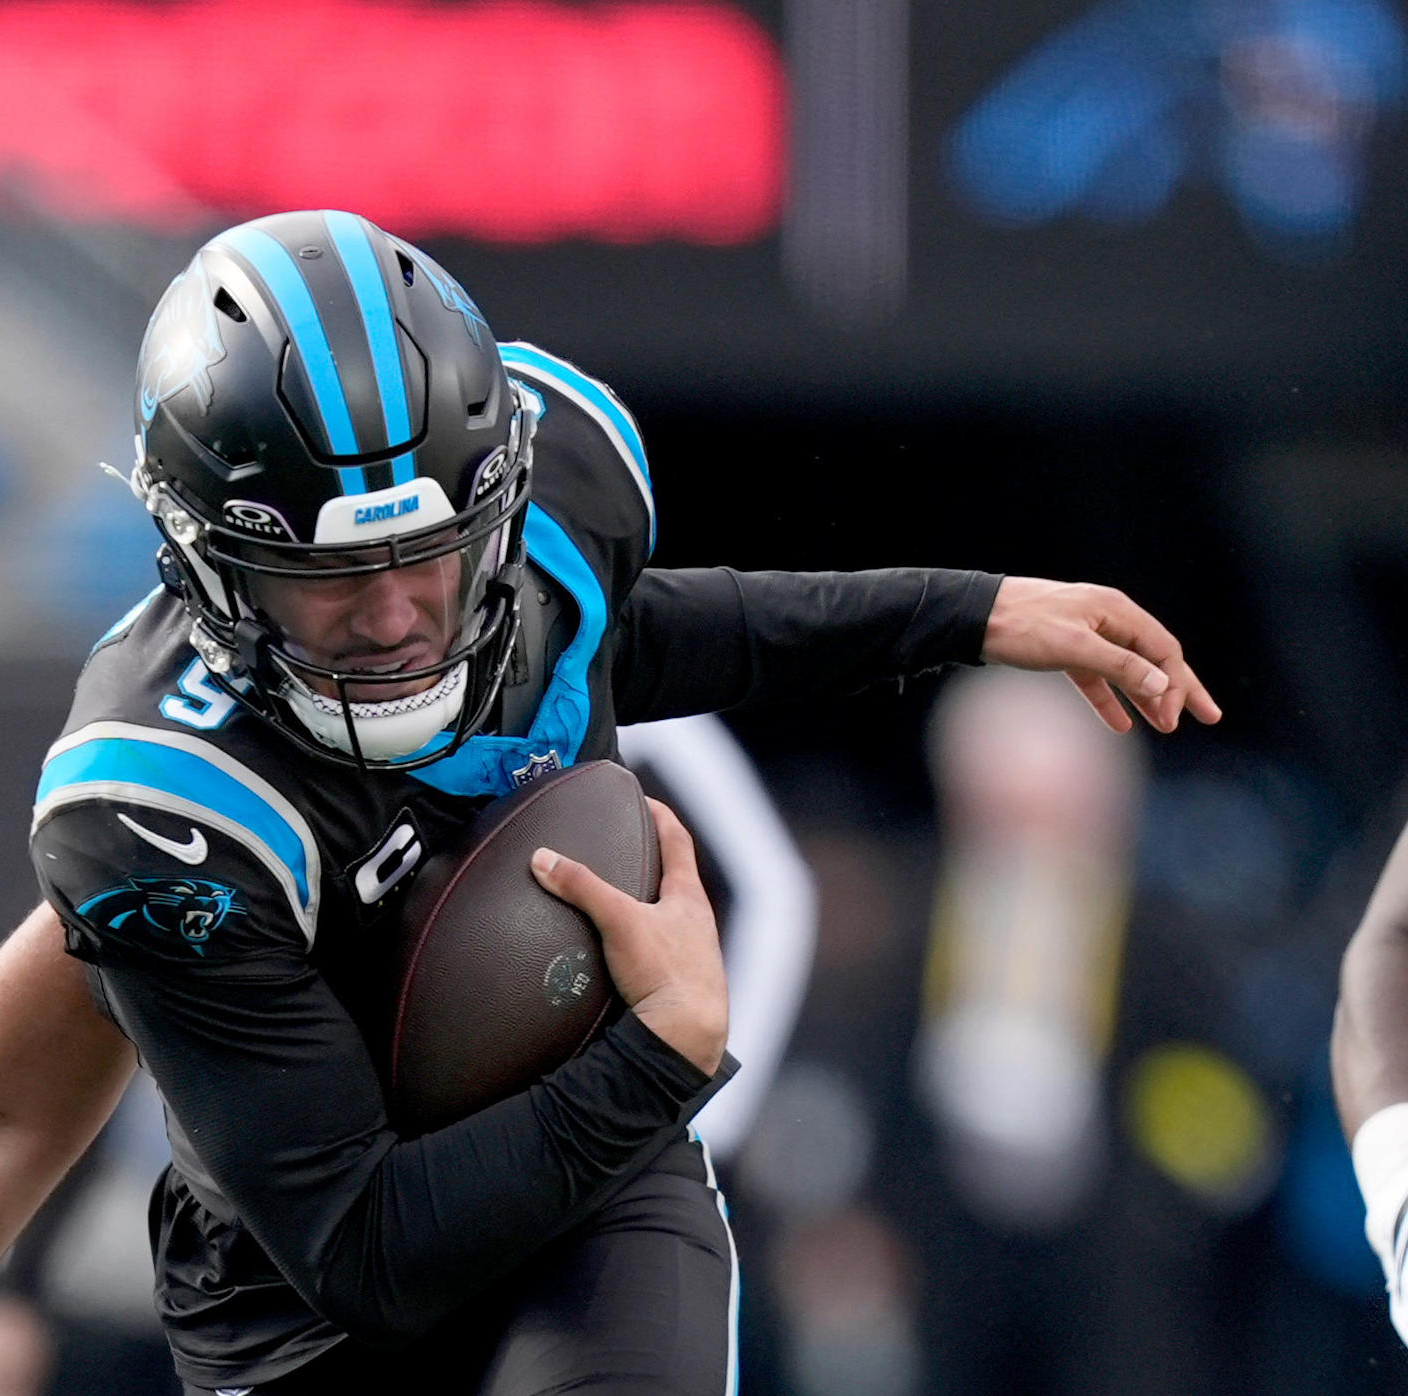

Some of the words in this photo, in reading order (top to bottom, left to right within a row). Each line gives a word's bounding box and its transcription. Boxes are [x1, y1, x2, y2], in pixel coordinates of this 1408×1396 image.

[225, 514, 284, 535] OAKLEY
[354, 495, 420, 525] CAROLINA
[355, 823, 423, 905] C
